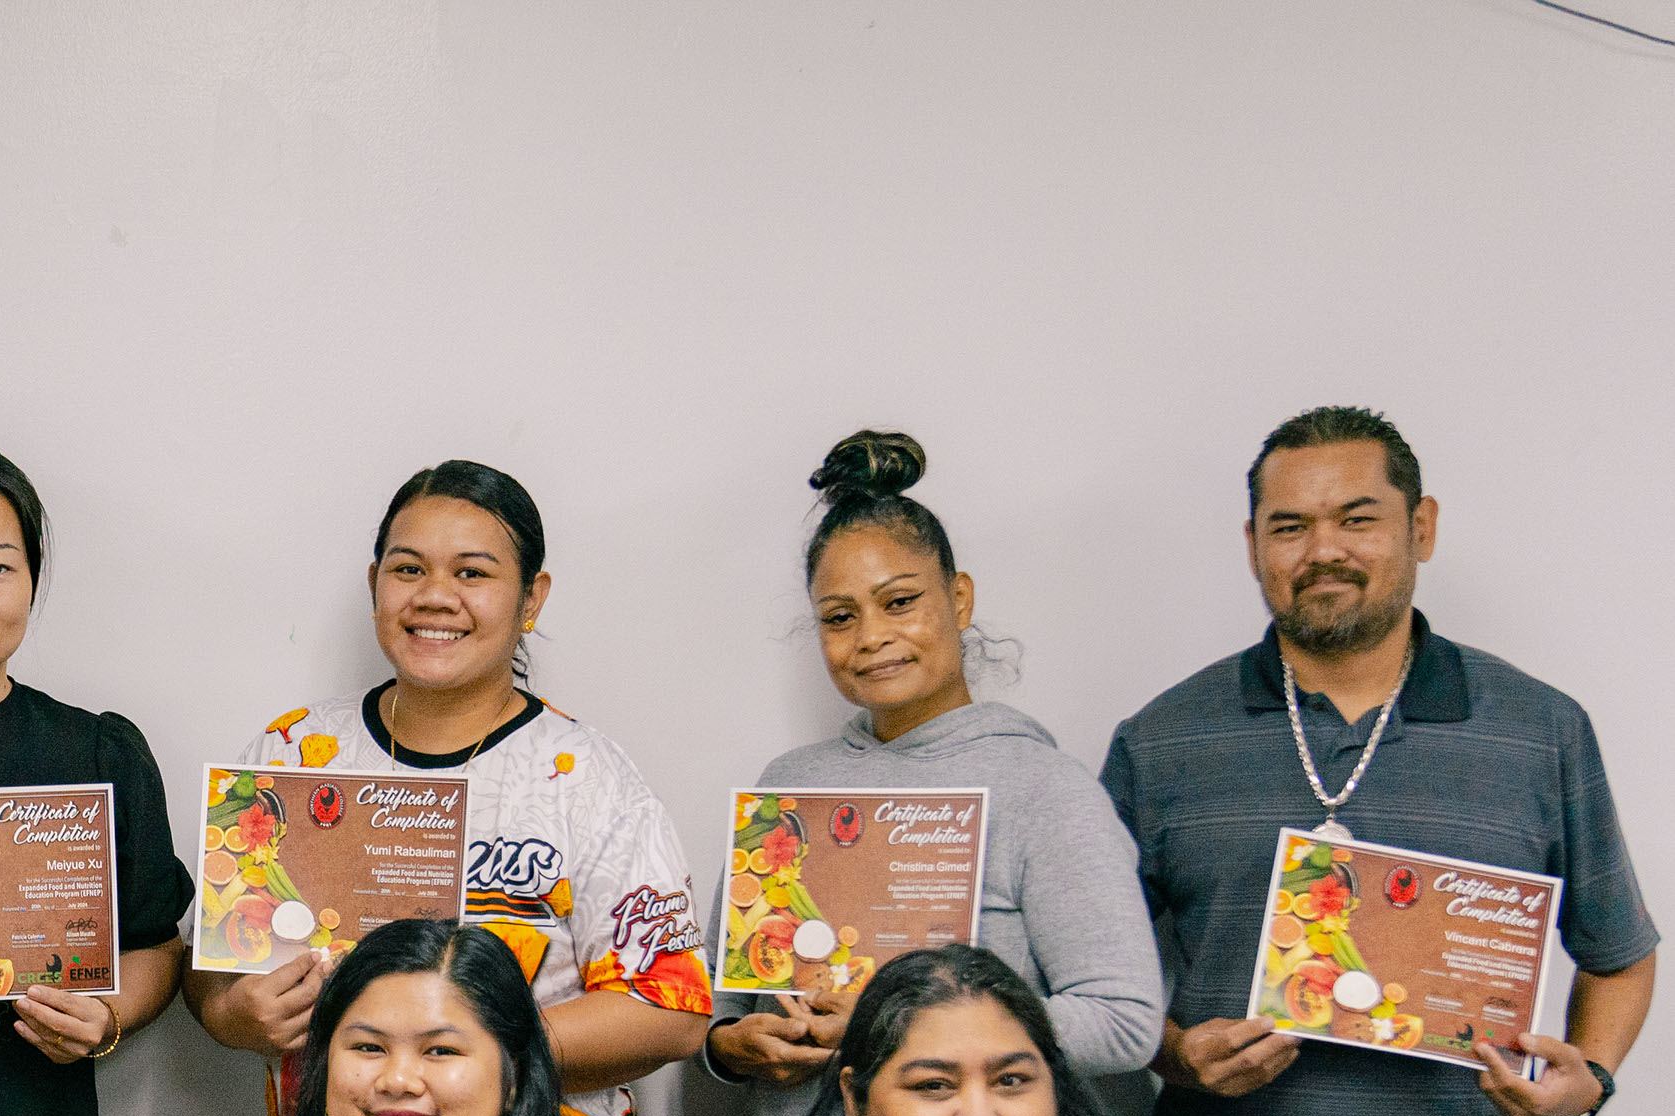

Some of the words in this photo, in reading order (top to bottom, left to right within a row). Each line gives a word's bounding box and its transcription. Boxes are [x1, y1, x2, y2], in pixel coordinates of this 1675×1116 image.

[356, 782, 438, 810] Certificate
[440, 789, 458, 812] of
[82, 800, 99, 823] of
[371, 805, 457, 831] Completion
[13, 821, 100, 846] Completion
[363, 844, 391, 855] Yumi
[394, 845, 456, 857] Rabauliman
[46, 859, 85, 873] Meiyue
[87, 858, 102, 868] Xu
[371, 868, 400, 876] Expanded
[18, 883, 47, 892] Expanded
[376, 876, 405, 884] Education
[405, 877, 430, 886] Program
[431, 877, 454, 886] (EFNEP)
[24, 891, 53, 899] Education
[54, 890, 79, 899] Program
[80, 888, 103, 897] (EFNEP)
[612, 887, 687, 948] Flame
[69, 966, 110, 981] EFNEP
